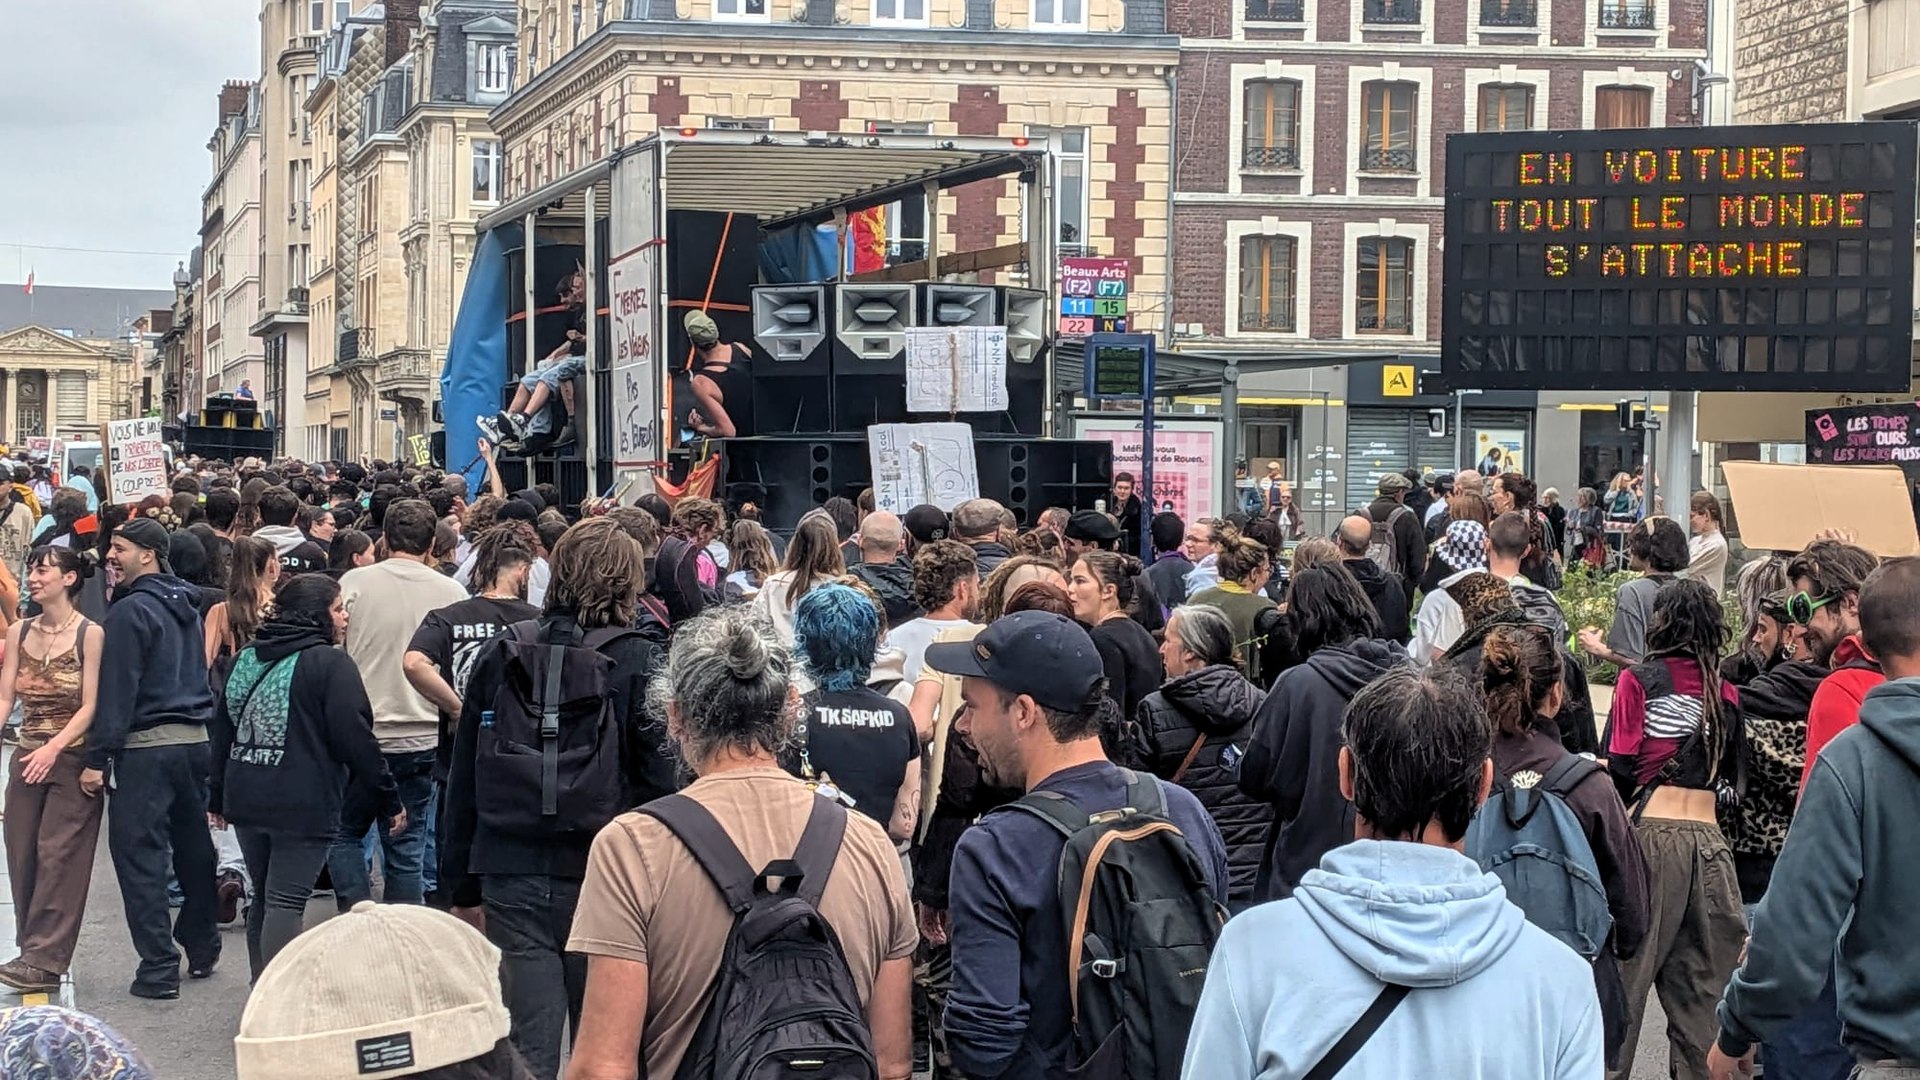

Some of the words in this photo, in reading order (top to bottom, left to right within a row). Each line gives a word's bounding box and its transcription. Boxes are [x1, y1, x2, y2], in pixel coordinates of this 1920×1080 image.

[1520, 151, 1574, 184] EN
[1605, 145, 1806, 183] VOITURE
[1492, 198, 1598, 232] TOUT
[1632, 196, 1687, 230] LE
[1720, 193, 1865, 228] MONDE
[1545, 241, 1803, 277] S'ATTACHE
[1063, 265, 1099, 278] Beaux
[1101, 266, 1127, 279] Arts
[1065, 278, 1092, 295] (F2)
[1098, 279, 1125, 296] (F7)
[1070, 300, 1086, 313] 11
[1102, 301, 1119, 314] 15
[1068, 320, 1086, 333] 22
[1104, 320, 1115, 332] N
[134, 421, 145, 438] NE
[1846, 416, 1869, 432] LES
[1870, 415, 1910, 431] TEMPS
[1161, 455, 1172, 463] de
[1833, 447, 1856, 461] LES
[112, 462, 123, 475] DE
[453, 623, 495, 639] FREE
